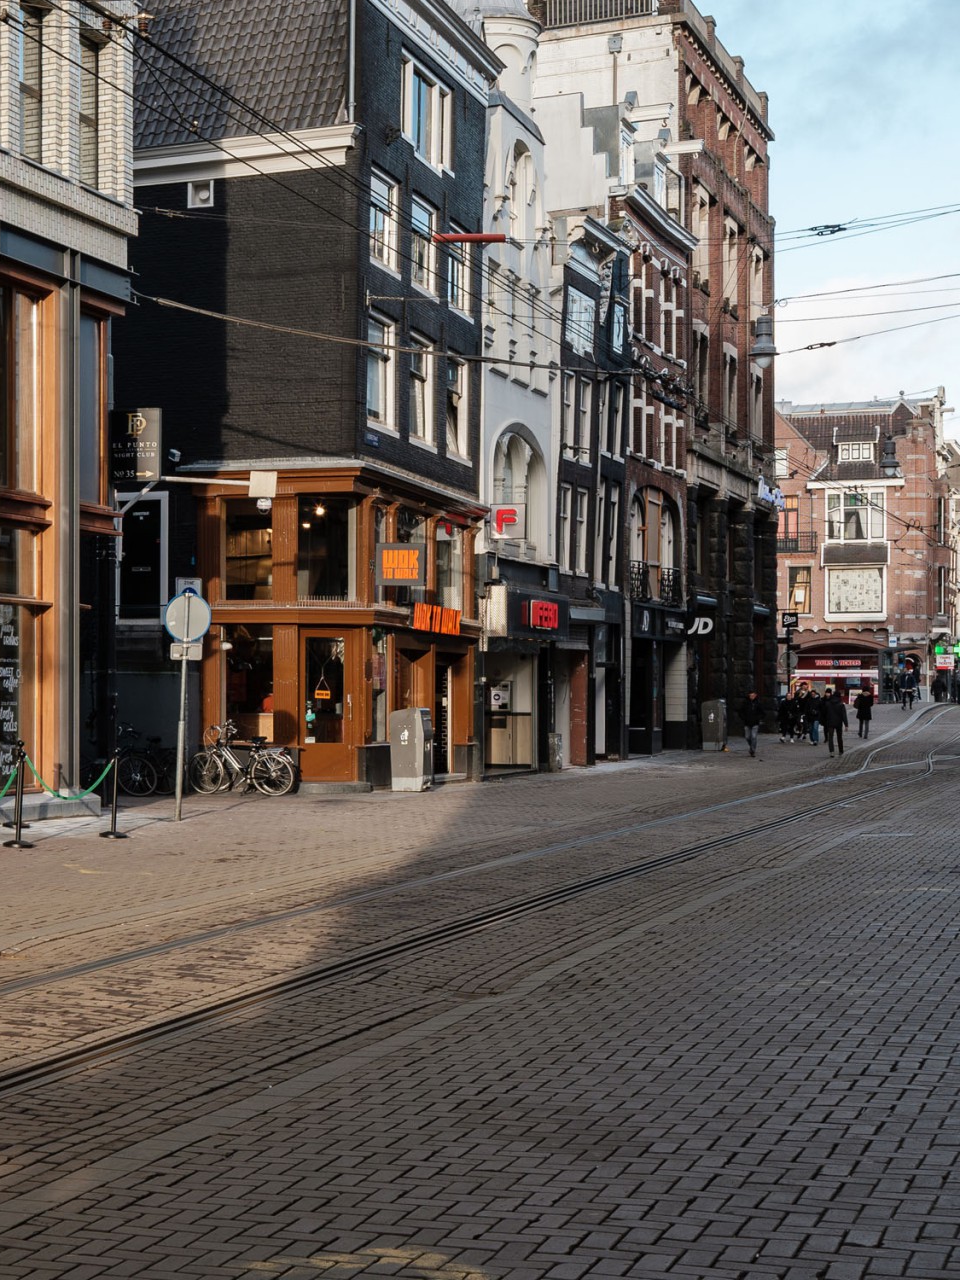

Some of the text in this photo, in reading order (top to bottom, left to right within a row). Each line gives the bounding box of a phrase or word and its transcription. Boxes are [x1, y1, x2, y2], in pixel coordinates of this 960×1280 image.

[496, 508, 518, 536] F
[383, 549, 419, 568] WOK
[383, 568, 419, 579] TO WALK
[688, 617, 714, 635] JD
